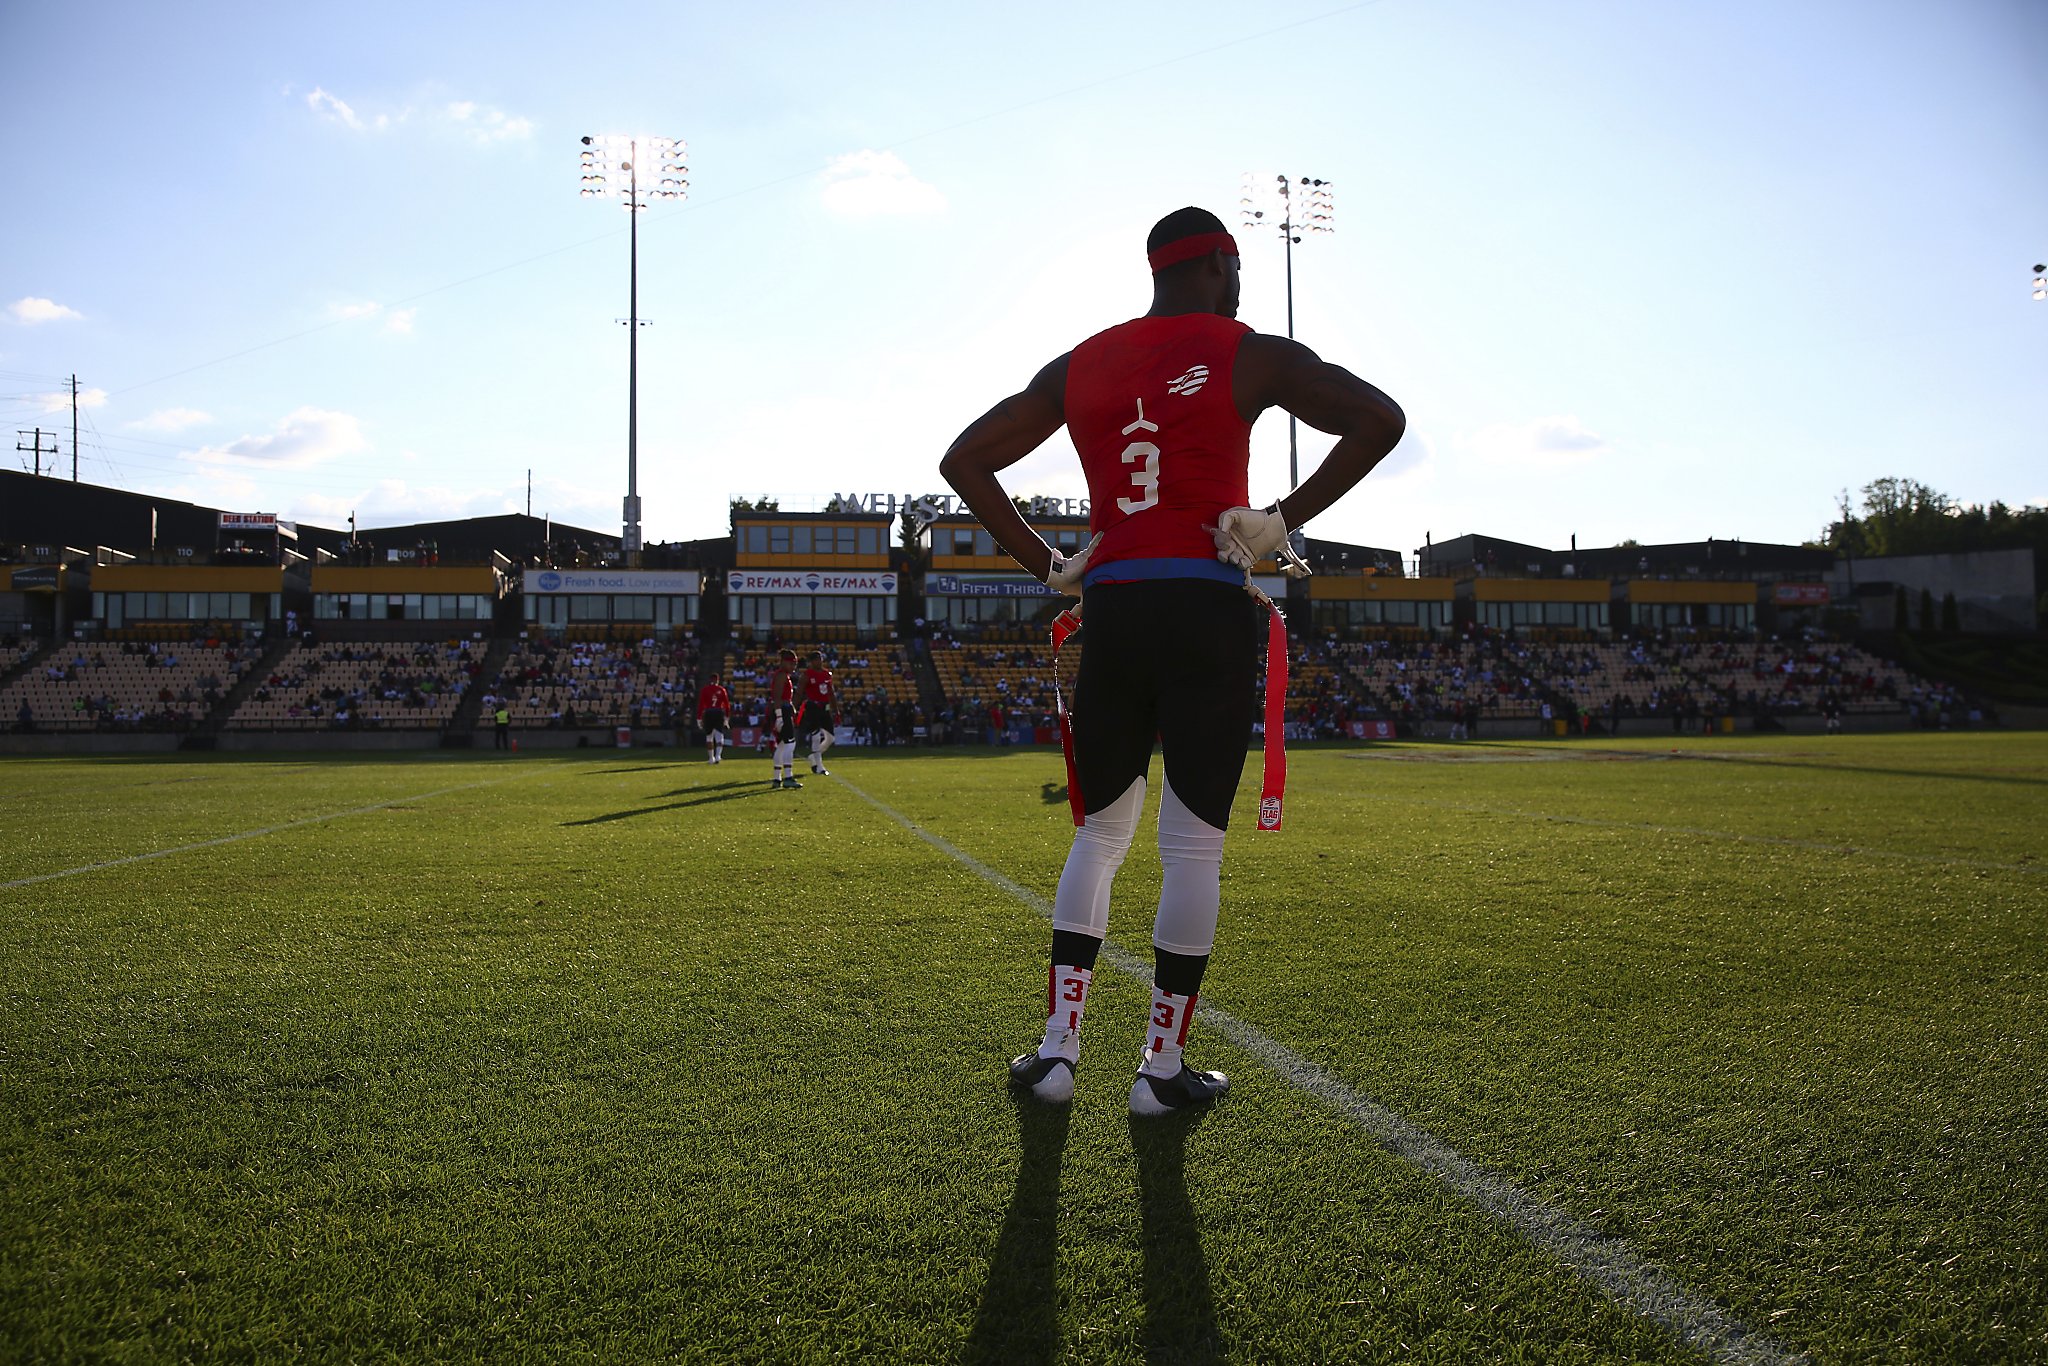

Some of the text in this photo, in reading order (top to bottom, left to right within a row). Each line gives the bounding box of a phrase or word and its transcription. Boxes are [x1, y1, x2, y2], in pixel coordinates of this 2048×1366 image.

[1117, 442, 1161, 515] 3
[834, 493, 1090, 523] WELLSTA PRES
[35, 547, 49, 556] 111
[177, 548, 193, 557] 110
[397, 550, 416, 558] 109
[565, 577, 595, 587] Fresh
[598, 577, 625, 587] food.
[629, 577, 650, 587] Low
[747, 577, 801, 588] RE/MAX
[824, 577, 877, 589] RE/MAX
[961, 583, 998, 594] FIFTH
[1003, 584, 1046, 595] THIRD
[1262, 810, 1278, 819] FLAG
[1063, 978, 1083, 1002] 3
[1153, 1002, 1174, 1029] 3
